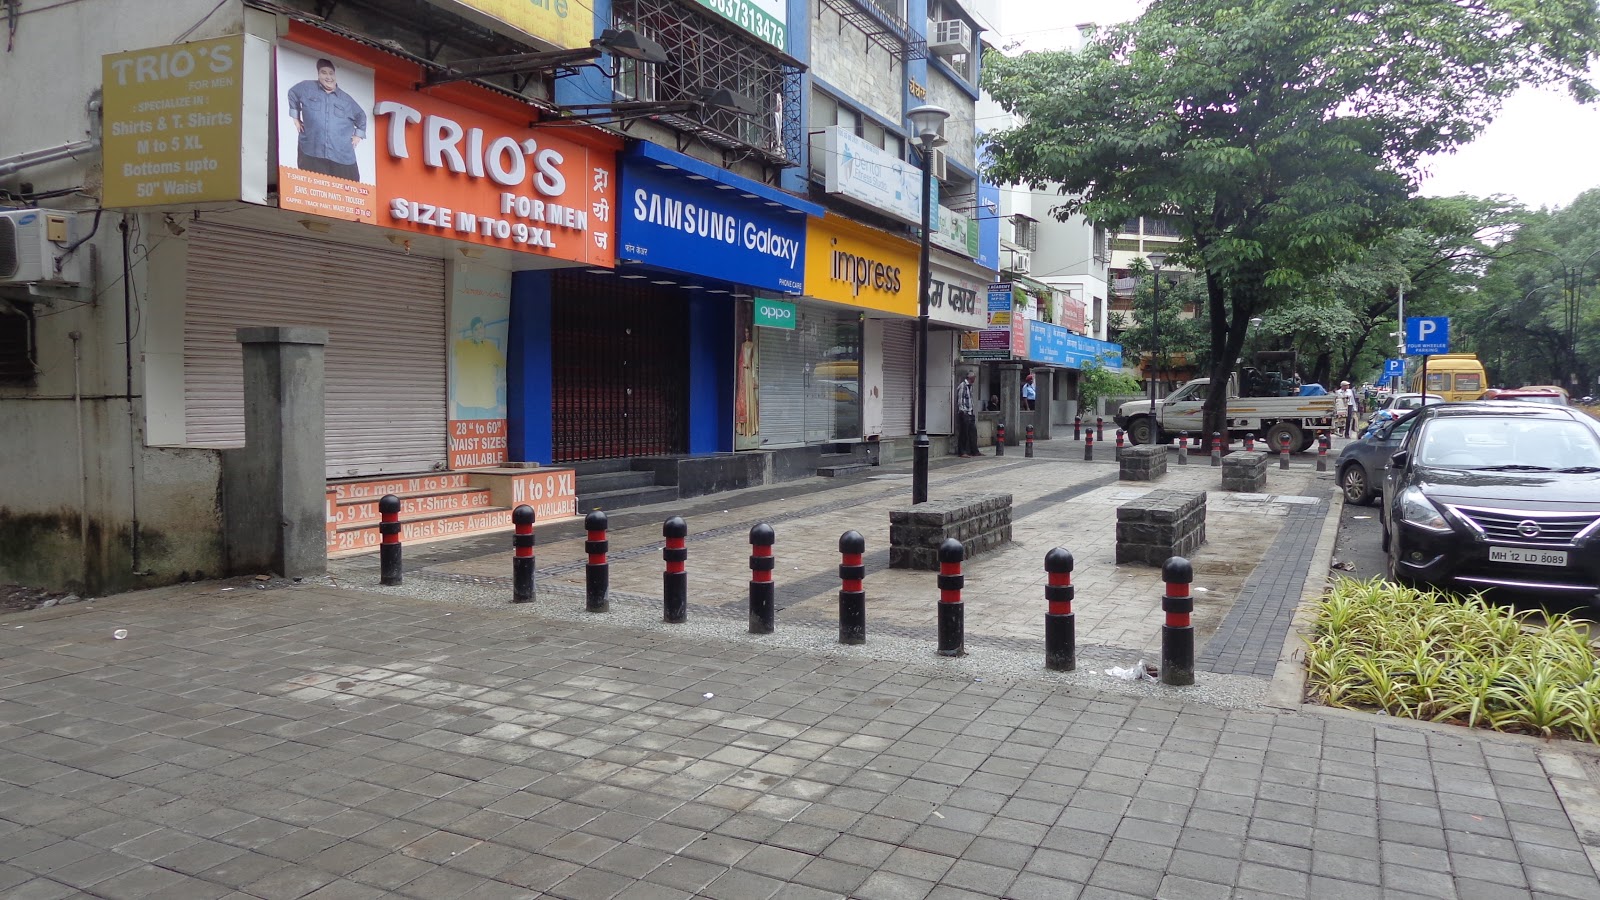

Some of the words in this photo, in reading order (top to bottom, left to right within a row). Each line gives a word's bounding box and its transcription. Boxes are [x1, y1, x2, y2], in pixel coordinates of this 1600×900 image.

[710, 0, 784, 50] 37313473
[112, 45, 233, 86] TRIO'S
[189, 80, 209, 90] FOR
[211, 78, 233, 88] MEN
[138, 98, 191, 112] SPECIALIZE
[194, 96, 204, 104] IN
[112, 121, 153, 136] Shirts
[157, 117, 168, 131] &
[188, 112, 233, 128] Shirts
[138, 140, 149, 154] M
[152, 139, 167, 153] to
[171, 137, 180, 151] 5
[184, 135, 203, 150] XL
[374, 101, 567, 197] TRIO'S
[124, 161, 181, 177] Bottoms
[185, 157, 218, 175] upto
[854, 152, 882, 177] Dental
[164, 180, 204, 196] Waist
[390, 197, 452, 229] SIZE
[455, 211, 476, 234] M
[501, 192, 545, 221] FOR
[546, 204, 587, 231] MEN
[634, 188, 735, 244] SAMSUNG
[744, 221, 799, 269] Galaxy
[831, 238, 900, 296] impress
[779, 278, 791, 288] PHONE
[792, 281, 802, 290] CARE
[1419, 320, 1436, 341] P
[1390, 360, 1398, 371] P
[475, 422, 485, 435] to
[481, 436, 507, 450] SIZES
[455, 452, 503, 467] AVAILABLE
[350, 484, 370, 497] for
[374, 482, 403, 496] men
[409, 478, 420, 492] M
[424, 477, 437, 491] to
[441, 476, 448, 489] 9
[452, 474, 467, 488] XL
[513, 479, 525, 503] M
[529, 478, 543, 501] to
[546, 475, 555, 499] 9
[558, 473, 574, 497] XL
[347, 505, 356, 521] 9
[360, 503, 376, 519] XL
[461, 493, 469, 507] &
[471, 494, 488, 506] etc
[536, 499, 575, 517] AVAILABLE
[363, 531, 377, 545] to
[402, 522, 434, 539] Waist
[437, 518, 464, 534] Sizes
[467, 511, 512, 530] Available
[1491, 551, 1507, 560] MH
[1510, 553, 1520, 561] 12
[1524, 553, 1538, 562] LD
[1541, 554, 1564, 565] 8089
